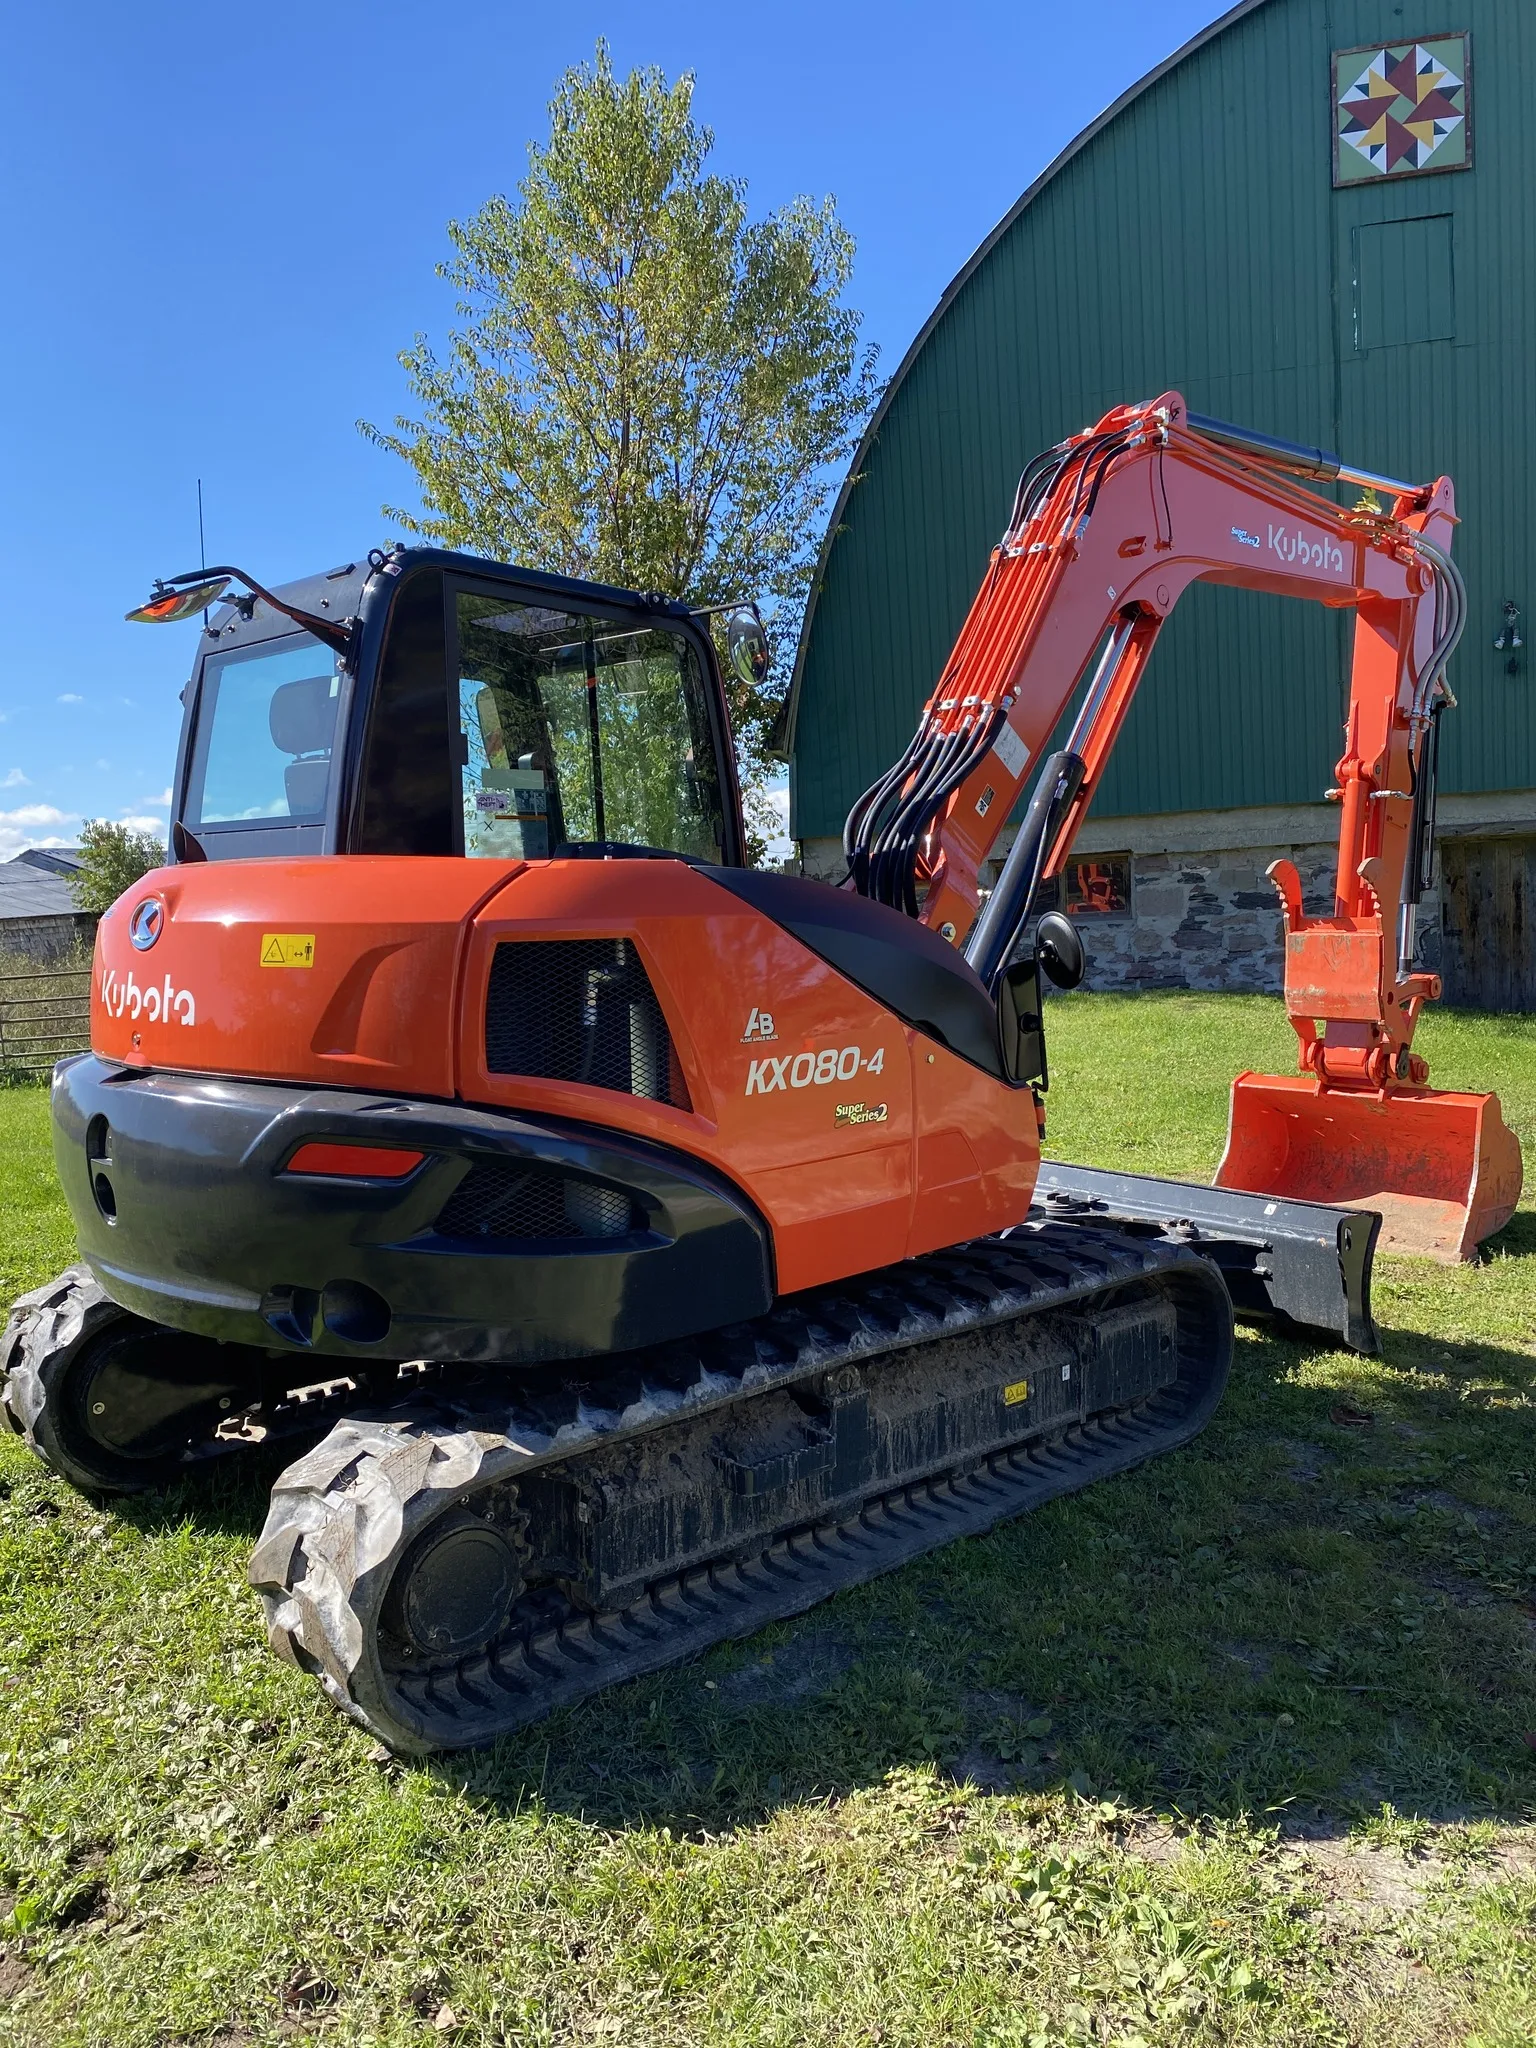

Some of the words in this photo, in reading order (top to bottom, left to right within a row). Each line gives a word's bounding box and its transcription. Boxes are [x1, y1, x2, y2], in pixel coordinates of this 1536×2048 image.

[1268, 524, 1343, 572] Kubota
[101, 969, 196, 1026] Kubota
[744, 1007, 775, 1037] AB
[745, 1046, 885, 1096] KX080-4
[835, 1103, 865, 1118] Super
